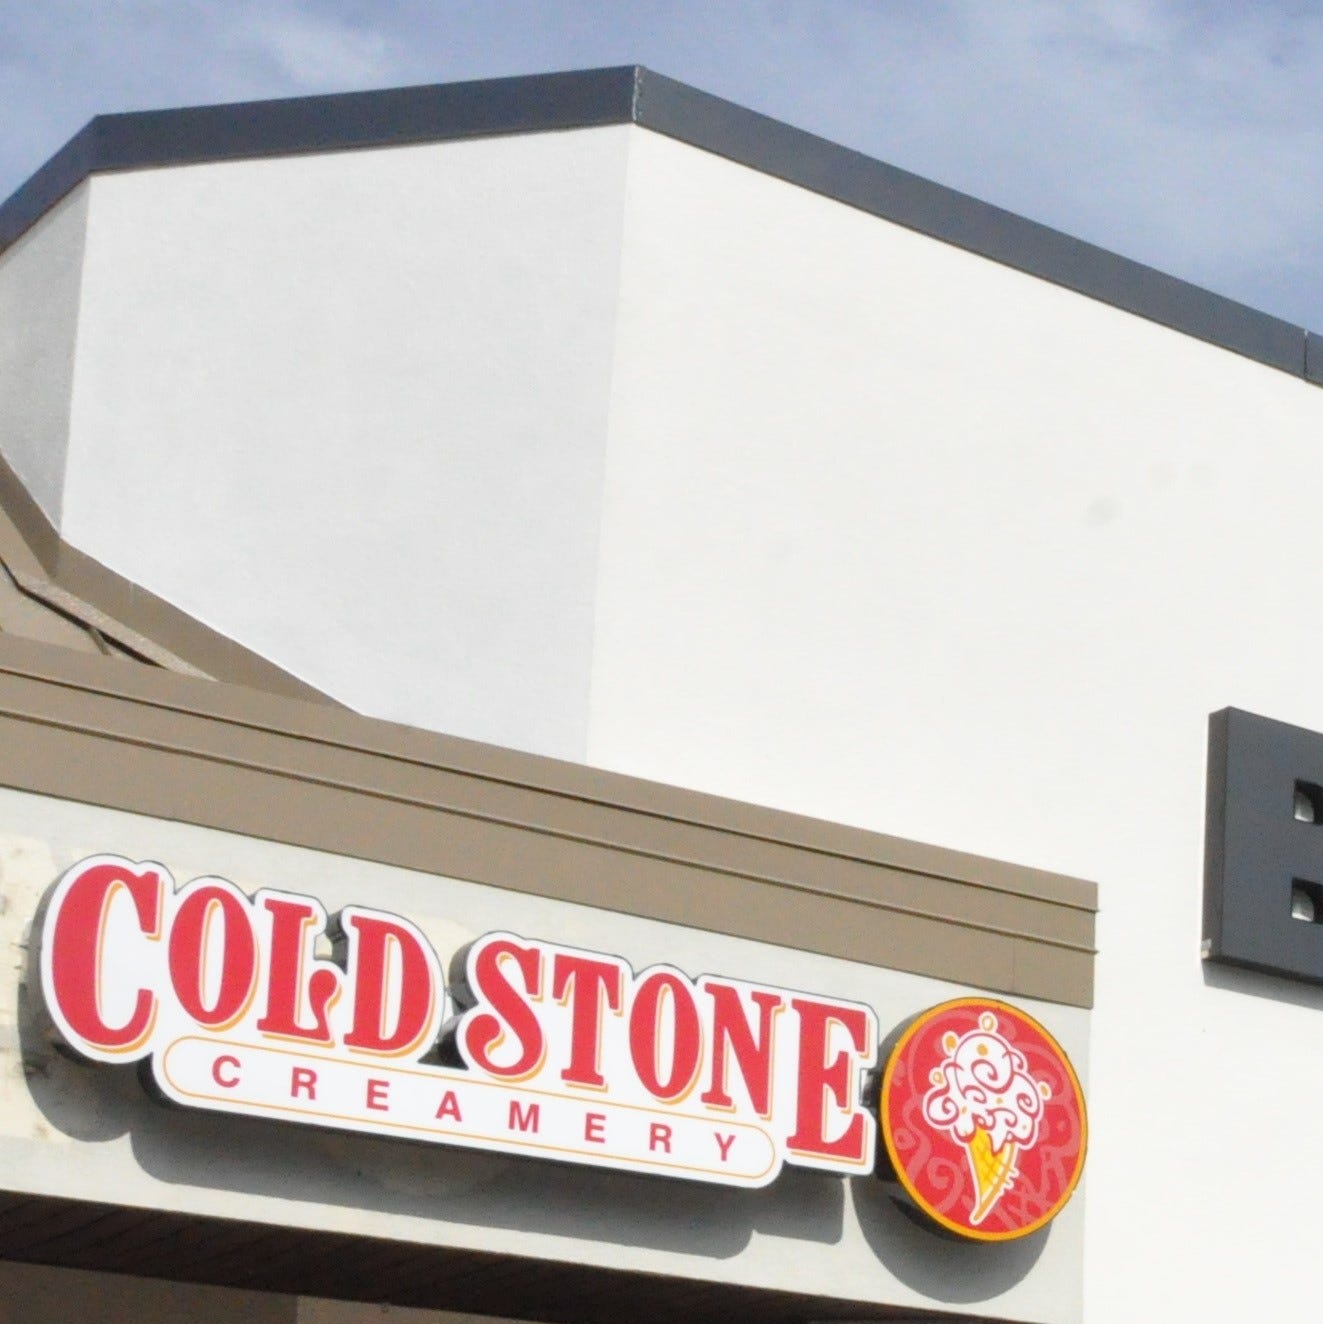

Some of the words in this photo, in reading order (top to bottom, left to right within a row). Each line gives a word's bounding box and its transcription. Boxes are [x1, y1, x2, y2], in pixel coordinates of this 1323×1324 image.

[51, 863, 434, 1055] COLD
[457, 937, 871, 1167] STONE
[211, 1053, 739, 1163] CREAMERY
